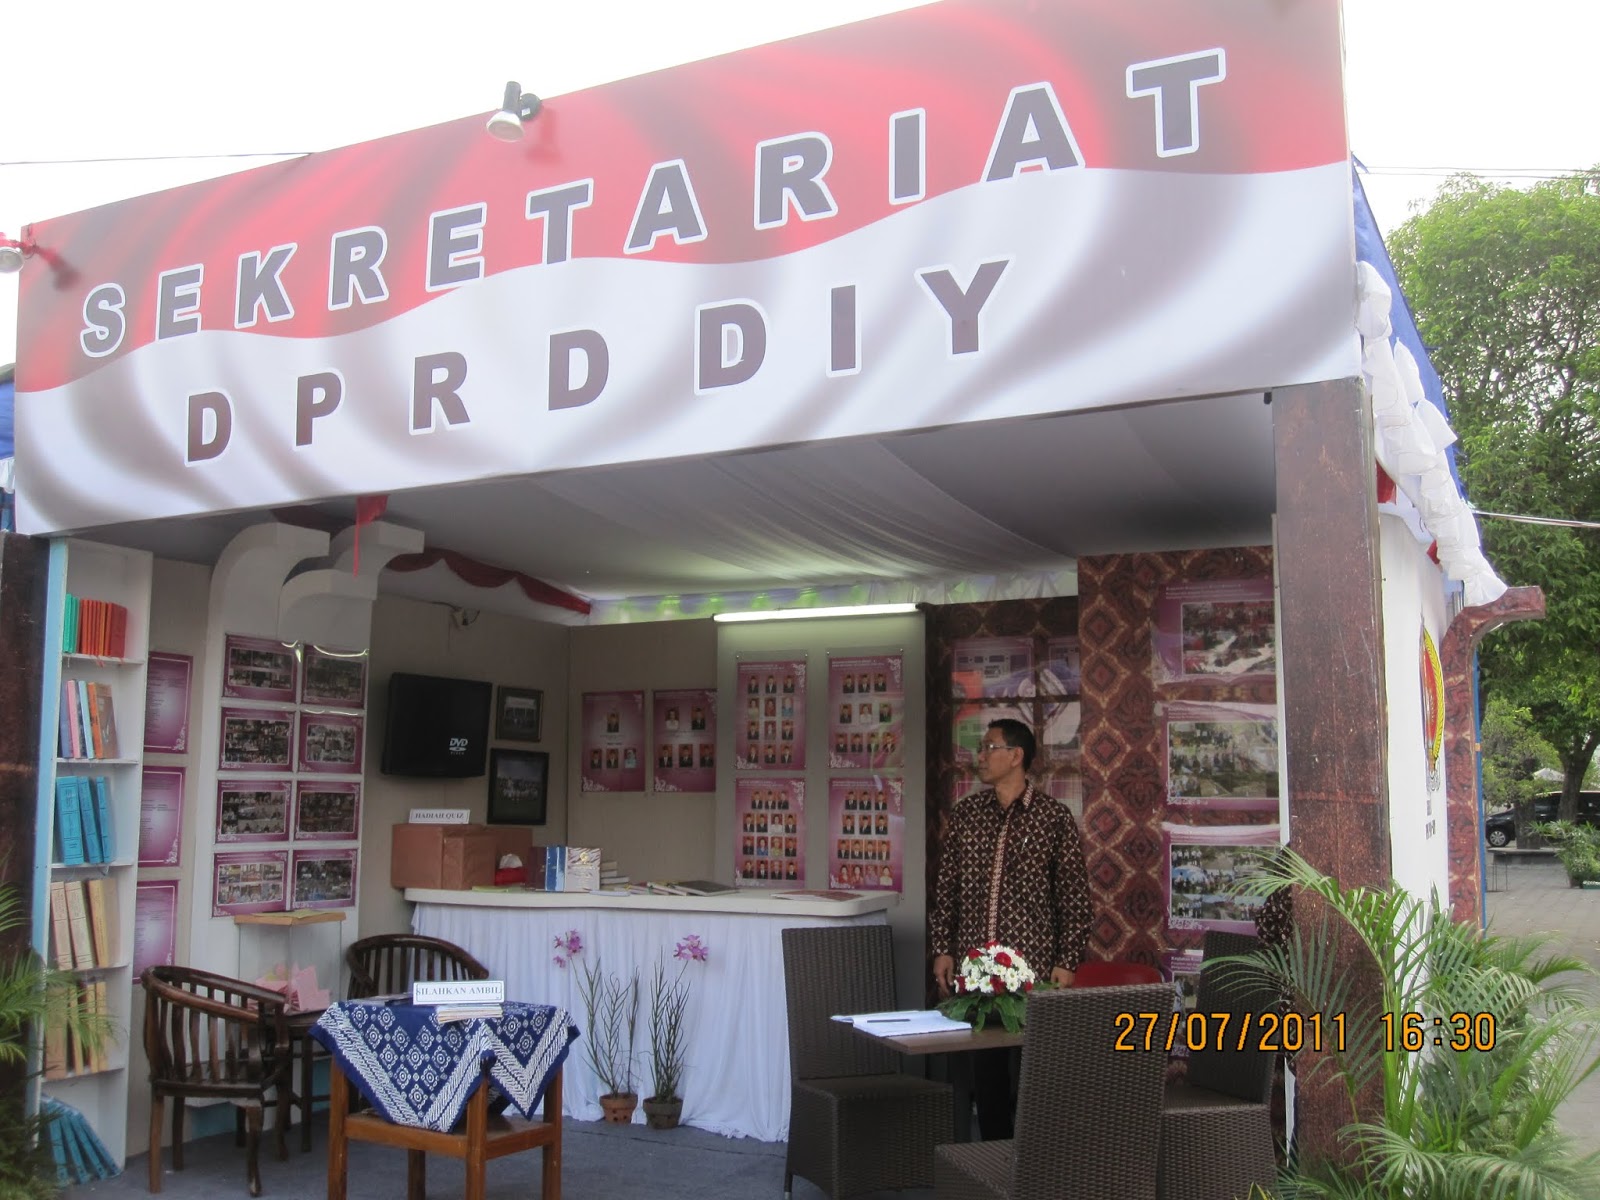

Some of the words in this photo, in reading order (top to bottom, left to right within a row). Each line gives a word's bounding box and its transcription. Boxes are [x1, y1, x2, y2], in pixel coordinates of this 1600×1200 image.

[80, 47, 1227, 360] SEKRETARIAT
[450, 738, 469, 746] DVD
[446, 812, 464, 820] QUIZ
[416, 987, 466, 996] SILAHKAN
[469, 986, 502, 994] AMBIL
